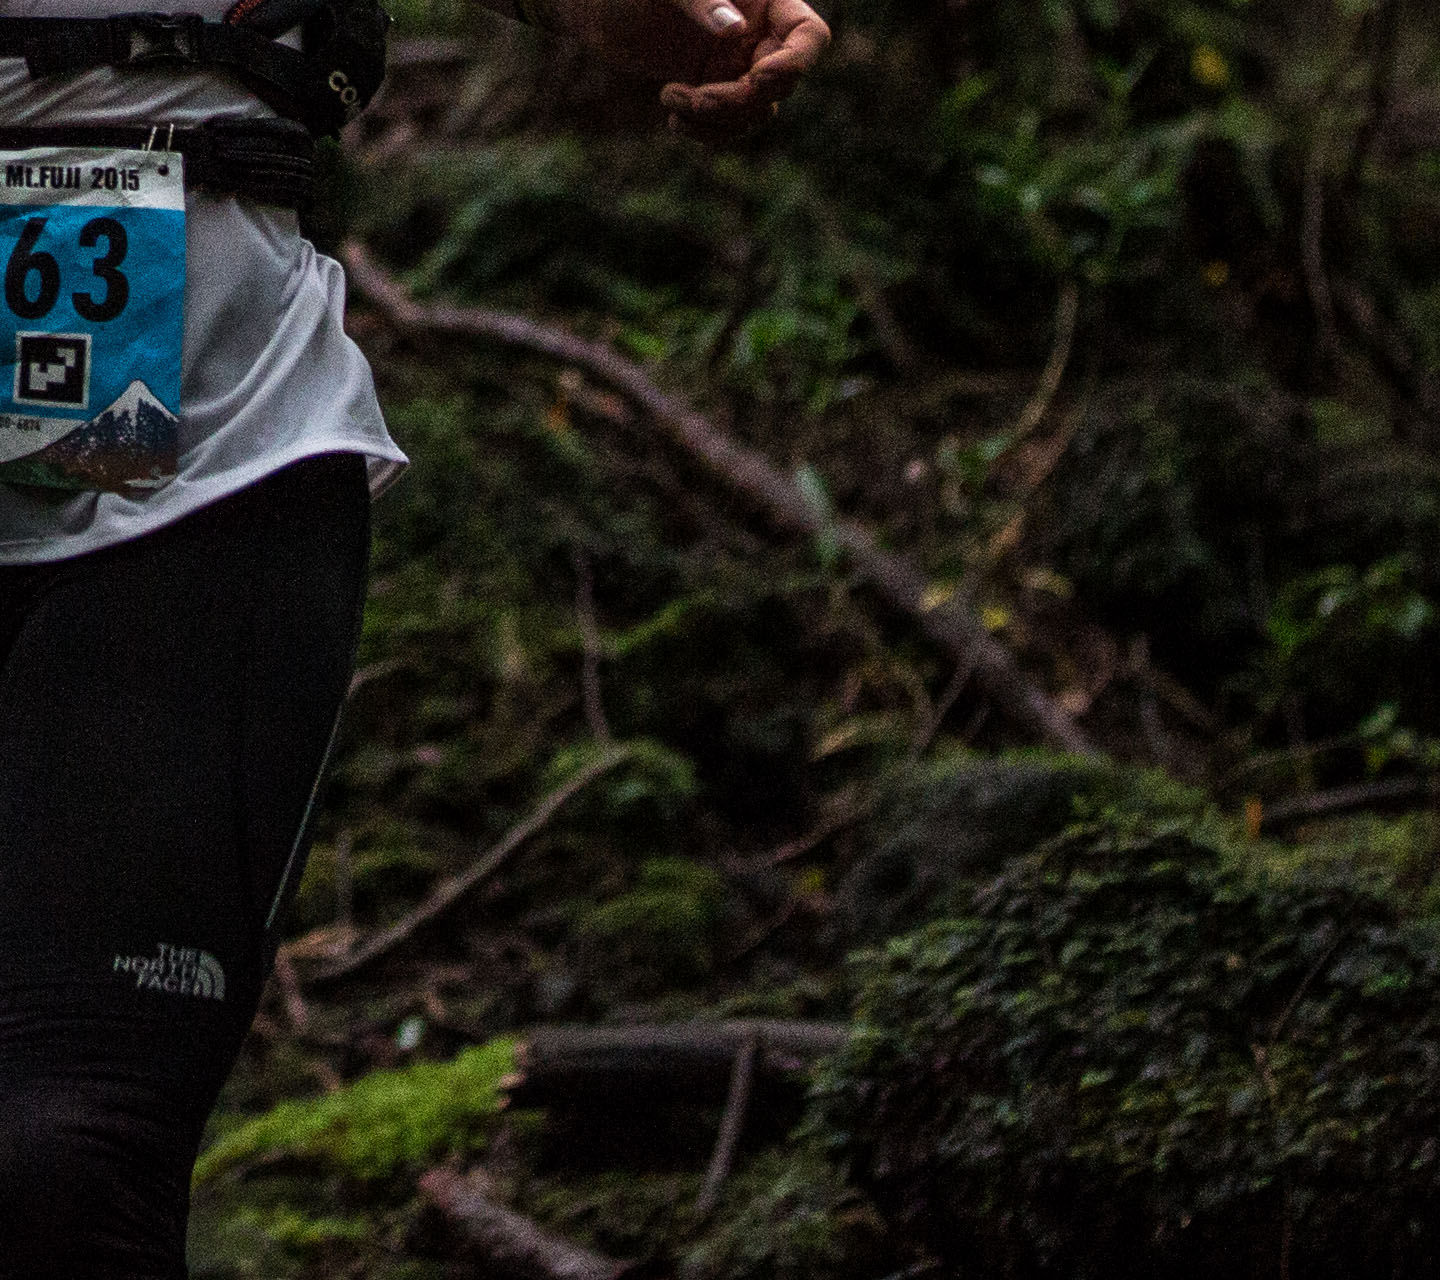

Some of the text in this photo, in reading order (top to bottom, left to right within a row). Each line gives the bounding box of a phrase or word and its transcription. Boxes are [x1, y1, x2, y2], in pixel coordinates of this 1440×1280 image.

[90, 166, 140, 191] 2015
[157, 942, 197, 963] THE
[136, 970, 194, 995] FACE
